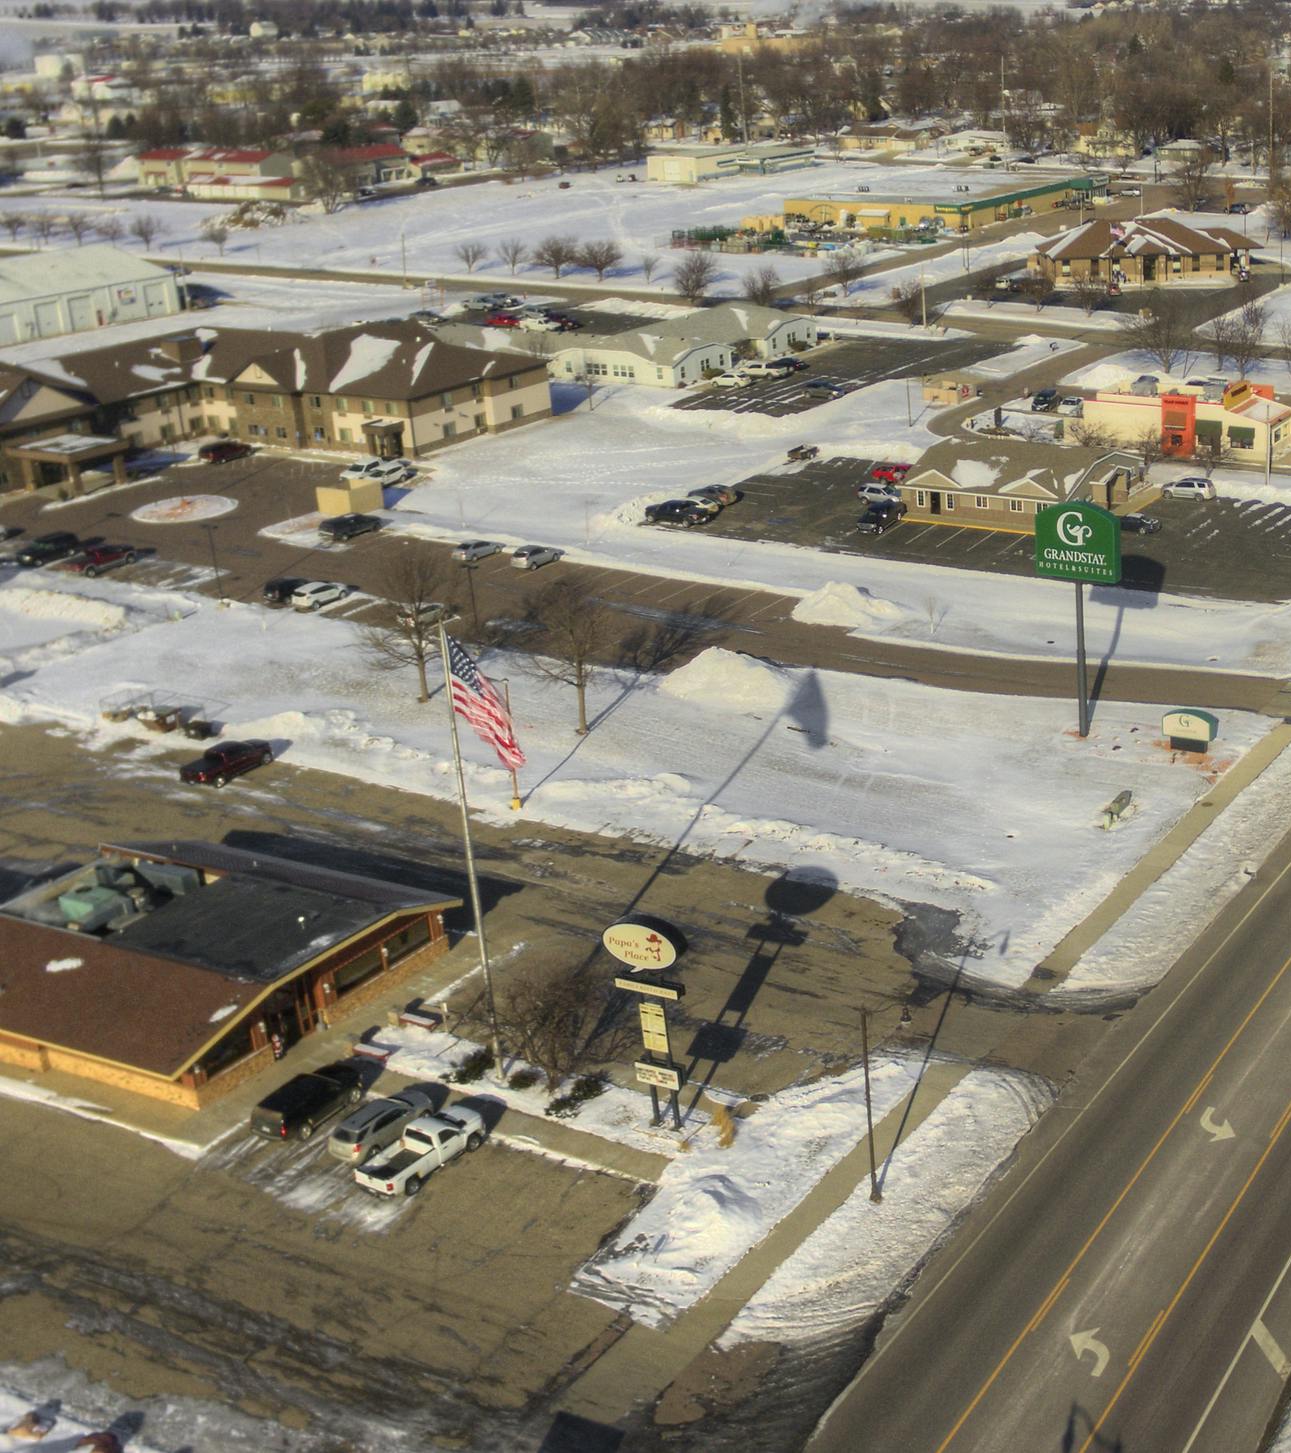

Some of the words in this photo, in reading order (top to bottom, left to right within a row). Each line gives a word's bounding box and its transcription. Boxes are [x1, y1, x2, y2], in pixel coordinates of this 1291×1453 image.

[1044, 548, 1105, 566] GRANDSTAY
[609, 936, 639, 948] Papa's
[624, 950, 649, 961] Place
